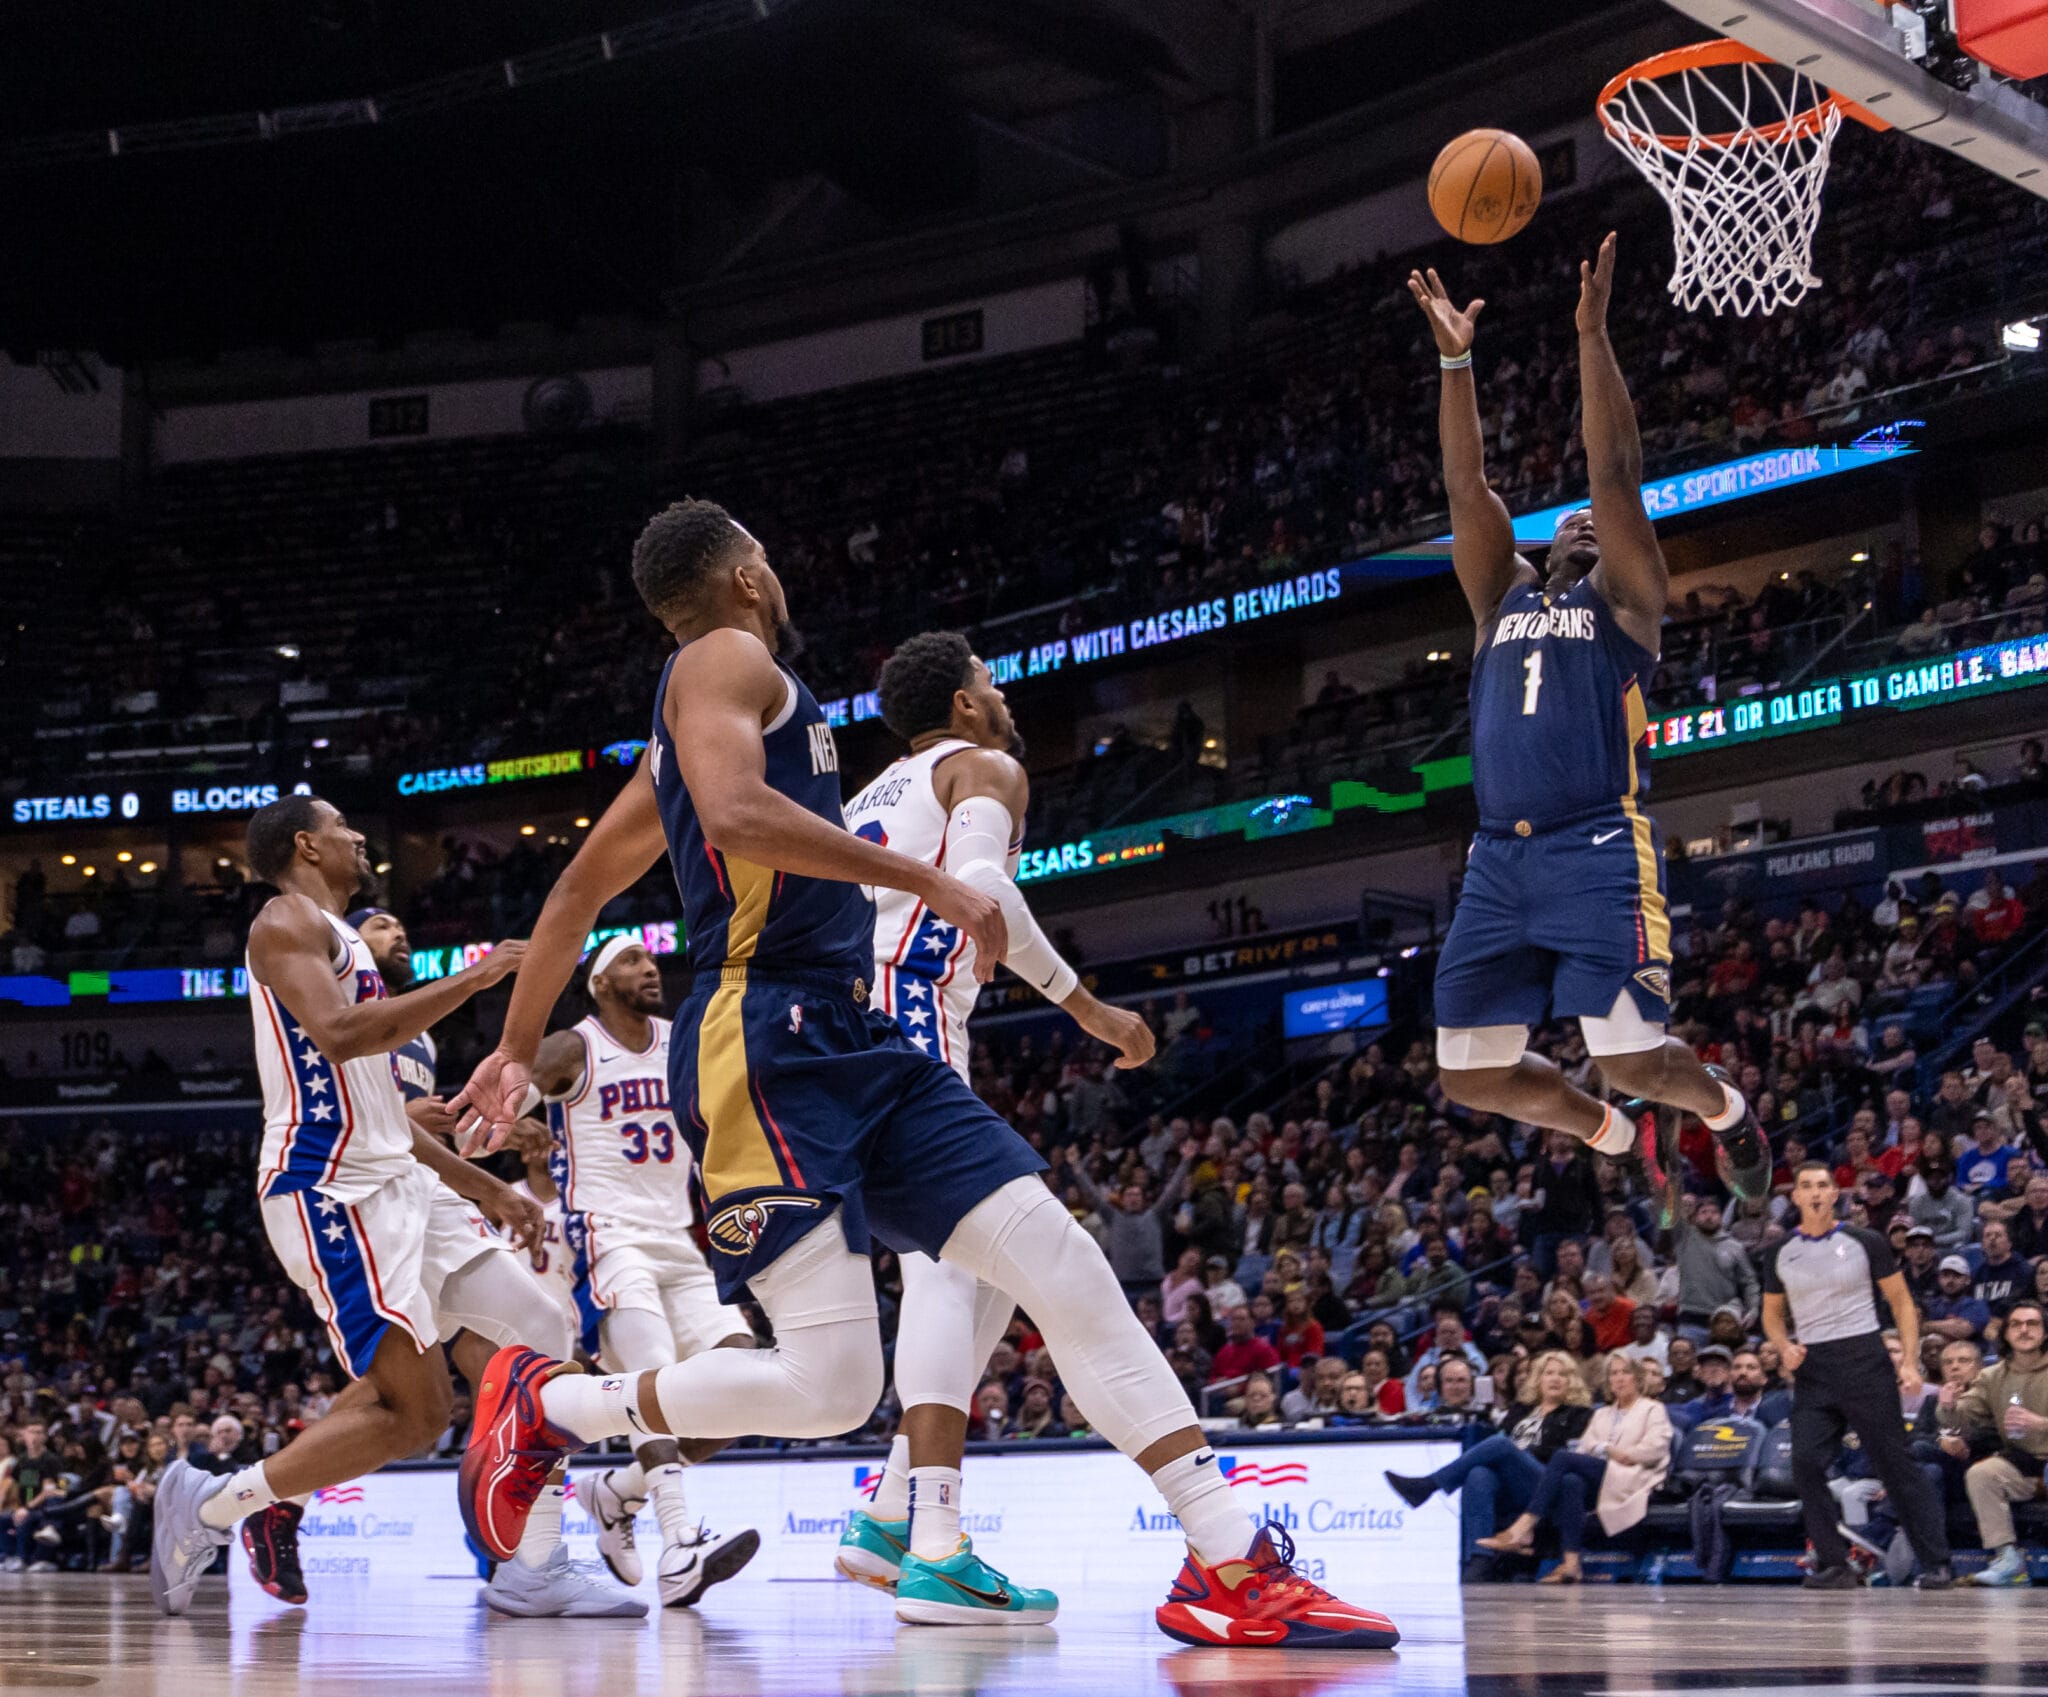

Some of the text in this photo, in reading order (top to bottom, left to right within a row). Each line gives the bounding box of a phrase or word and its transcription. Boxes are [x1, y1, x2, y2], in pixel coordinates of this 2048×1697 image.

[928, 317, 978, 353] 313
[1682, 444, 1820, 504] SPORTSBOOK
[1027, 641, 1067, 677] APP
[1070, 625, 1125, 664] WITH
[1130, 599, 1225, 650] CAESARS
[1232, 568, 1341, 623] REWARDS
[1491, 611, 1539, 648] NEW
[1522, 650, 1543, 715] 1
[1663, 715, 1693, 746] BE
[1698, 708, 1727, 739] 21
[1734, 702, 1764, 732] OR
[1770, 681, 1842, 724] OLDER
[1848, 677, 1879, 708] TO
[1888, 656, 1993, 701] GAMBLE.
[398, 751, 583, 795] CAESARS SPORTSBOOK
[13, 792, 139, 822] STEALS 0
[172, 785, 279, 812] BLOCKS
[1016, 840, 1093, 880] ESARS
[1766, 841, 1875, 876] PELICANS RADIO
[182, 968, 225, 998] THE
[60, 1030, 110, 1069] 109
[621, 1121, 673, 1165] 33
[1308, 1500, 1404, 1533] Caritas
